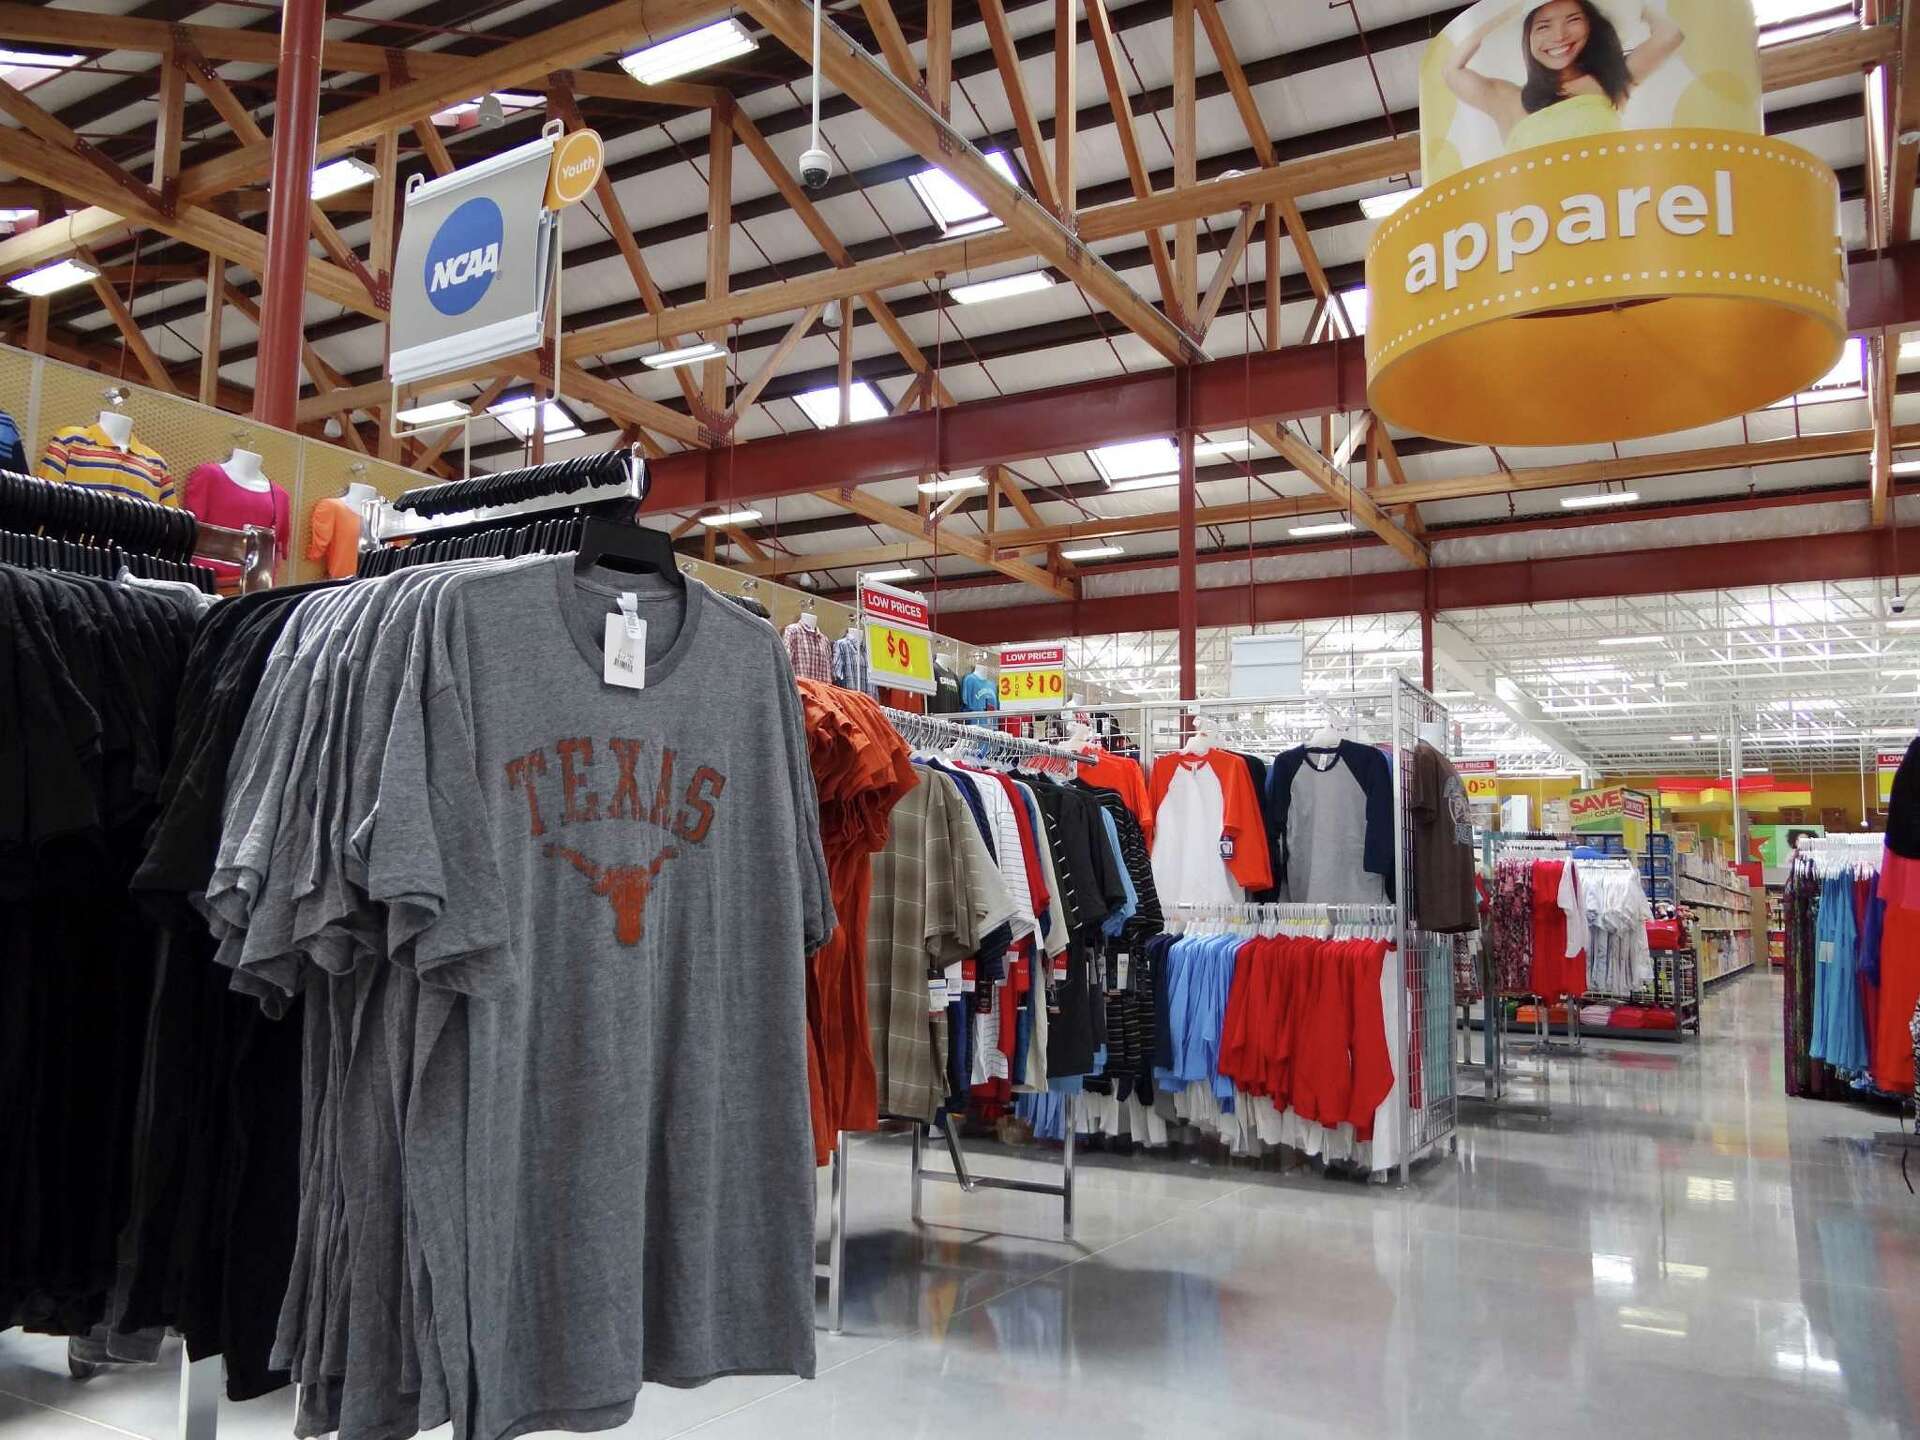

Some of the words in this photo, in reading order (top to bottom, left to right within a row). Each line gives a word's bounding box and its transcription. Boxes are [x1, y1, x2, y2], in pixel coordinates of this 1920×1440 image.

[561, 154, 596, 180] Youth
[1403, 169, 1734, 294] apparel
[430, 242, 499, 293] NCAA
[867, 593, 889, 609] LOW
[891, 600, 922, 618] PRICES
[1006, 652, 1026, 662] LOW
[1028, 650, 1059, 661] PRICES
[1001, 676, 1011, 696] 3
[1569, 790, 1621, 814] SAVE
